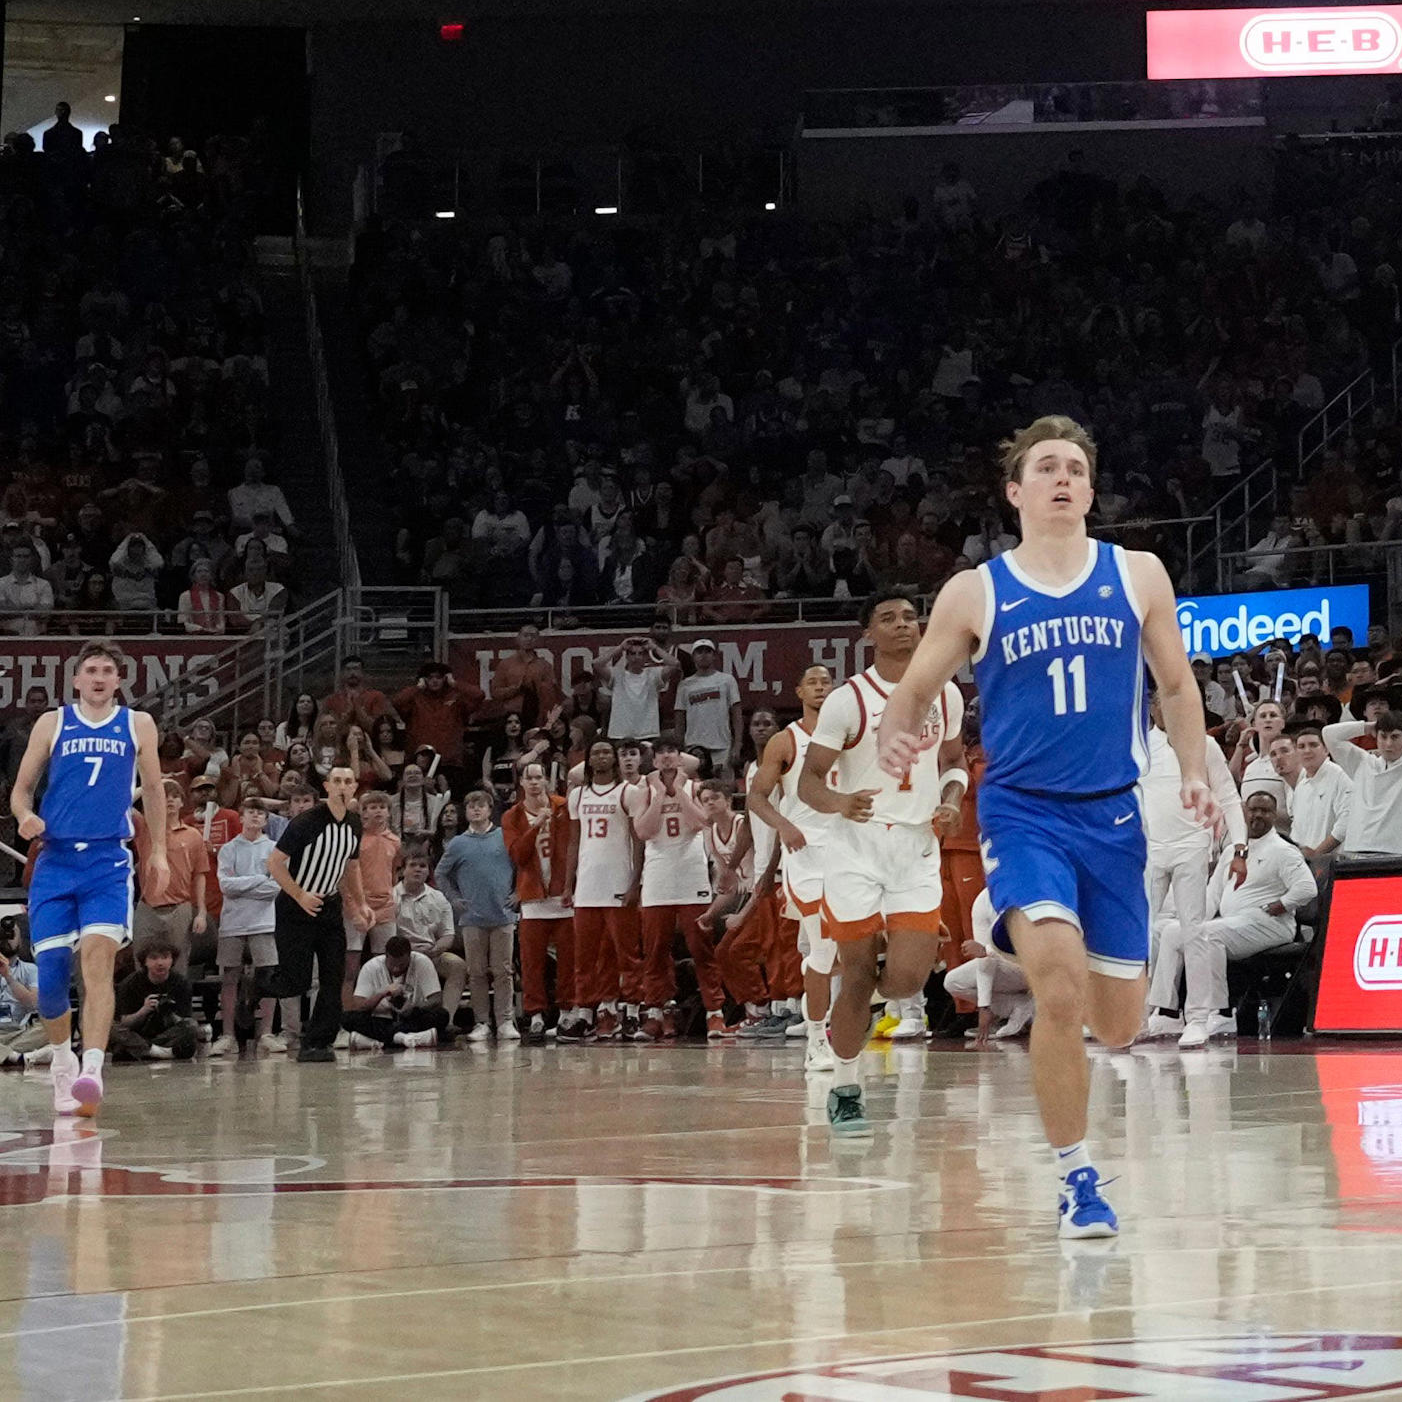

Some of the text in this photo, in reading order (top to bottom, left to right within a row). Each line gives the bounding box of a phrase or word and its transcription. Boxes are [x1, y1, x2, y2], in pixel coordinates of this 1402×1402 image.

[1177, 598, 1331, 654] indeed
[1001, 616, 1125, 665] KENTUCKY
[1047, 655, 1087, 716] 11
[62, 737, 127, 758] KENTUCKY
[84, 757, 103, 786] 7
[582, 804, 617, 815] TEXAS
[587, 817, 609, 838] 13
[666, 816, 681, 837] 8
